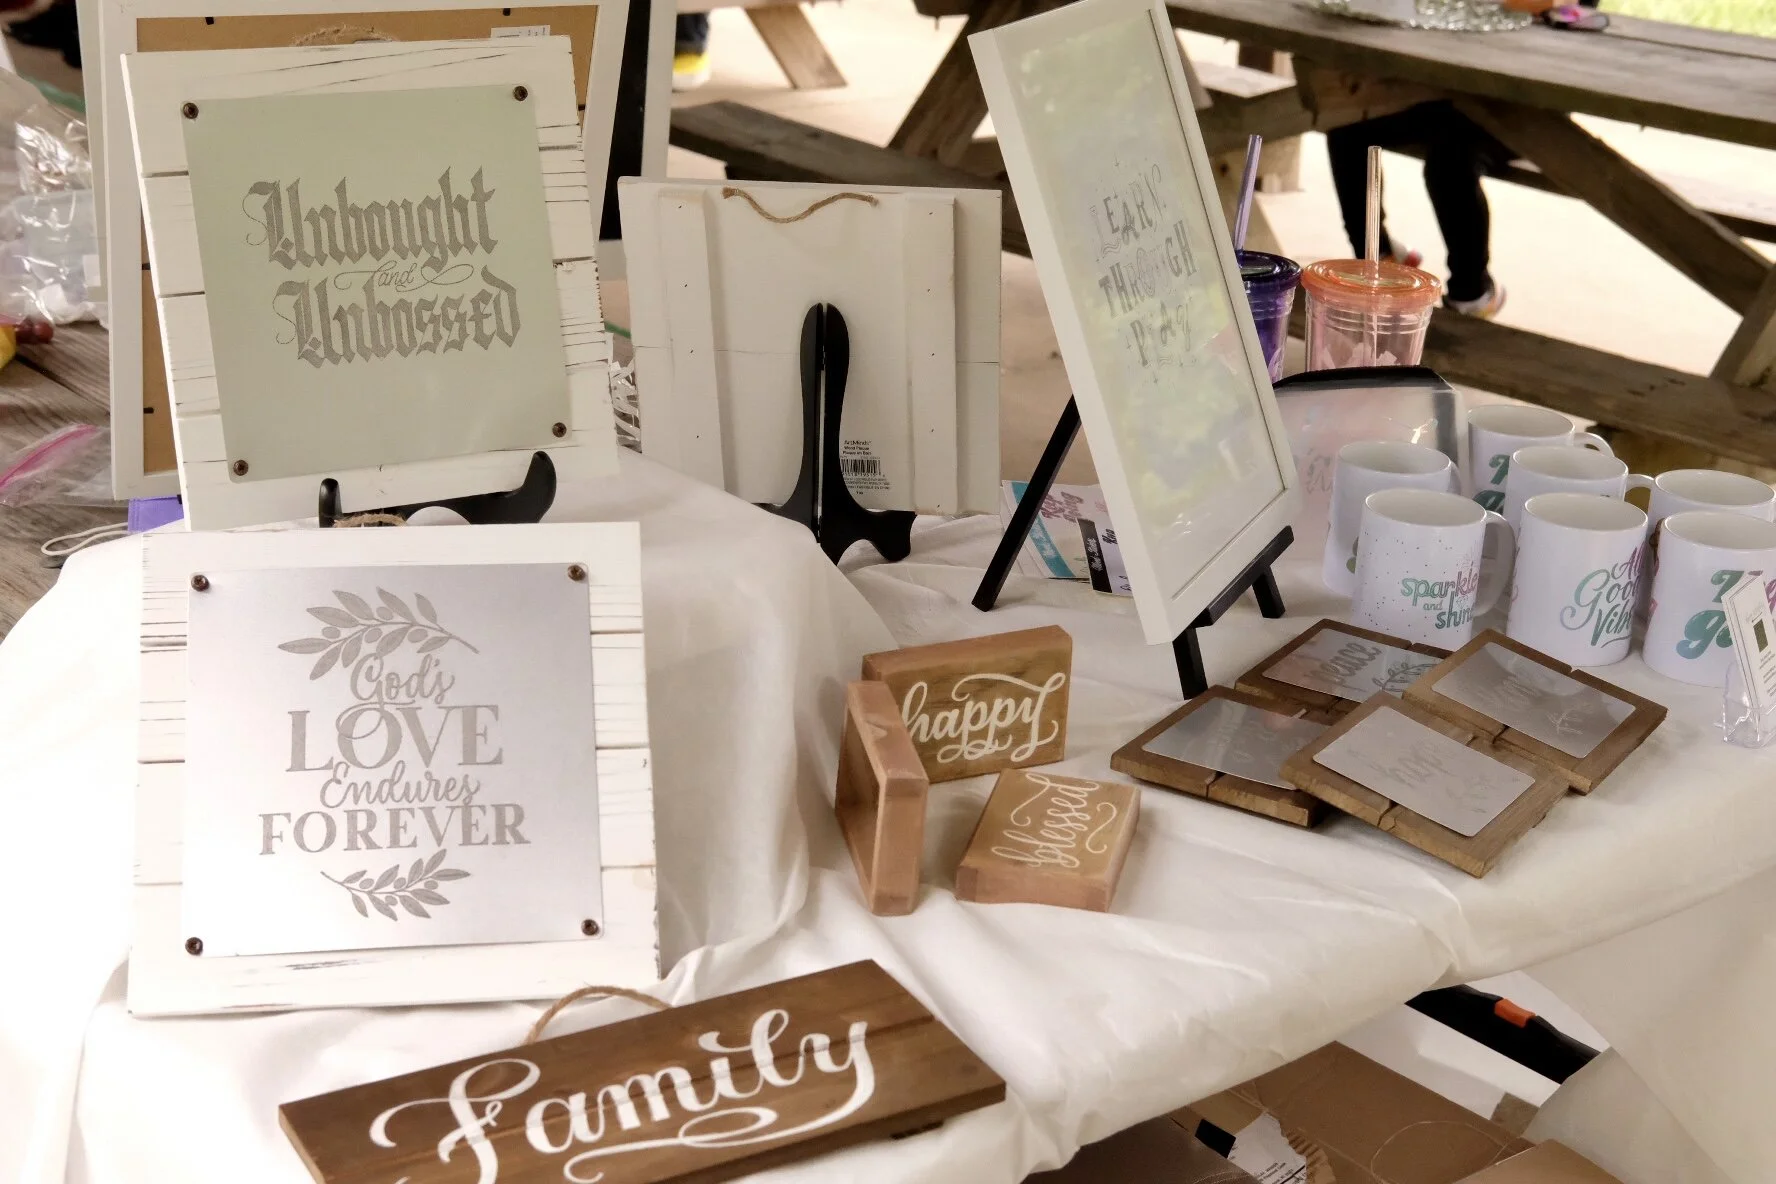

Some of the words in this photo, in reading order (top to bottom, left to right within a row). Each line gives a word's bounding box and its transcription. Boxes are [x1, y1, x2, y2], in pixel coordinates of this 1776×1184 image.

[243, 166, 499, 272] Unbought
[1401, 561, 1477, 607] sparkle
[1423, 600, 1442, 611] and
[1435, 591, 1473, 629] shin
[286, 704, 503, 773] LOVE
[902, 672, 1066, 764] happy
[320, 760, 480, 809] Endures
[259, 803, 531, 856] FOREVER
[991, 773, 1103, 869] blessed
[369, 1008, 876, 1184] Family
